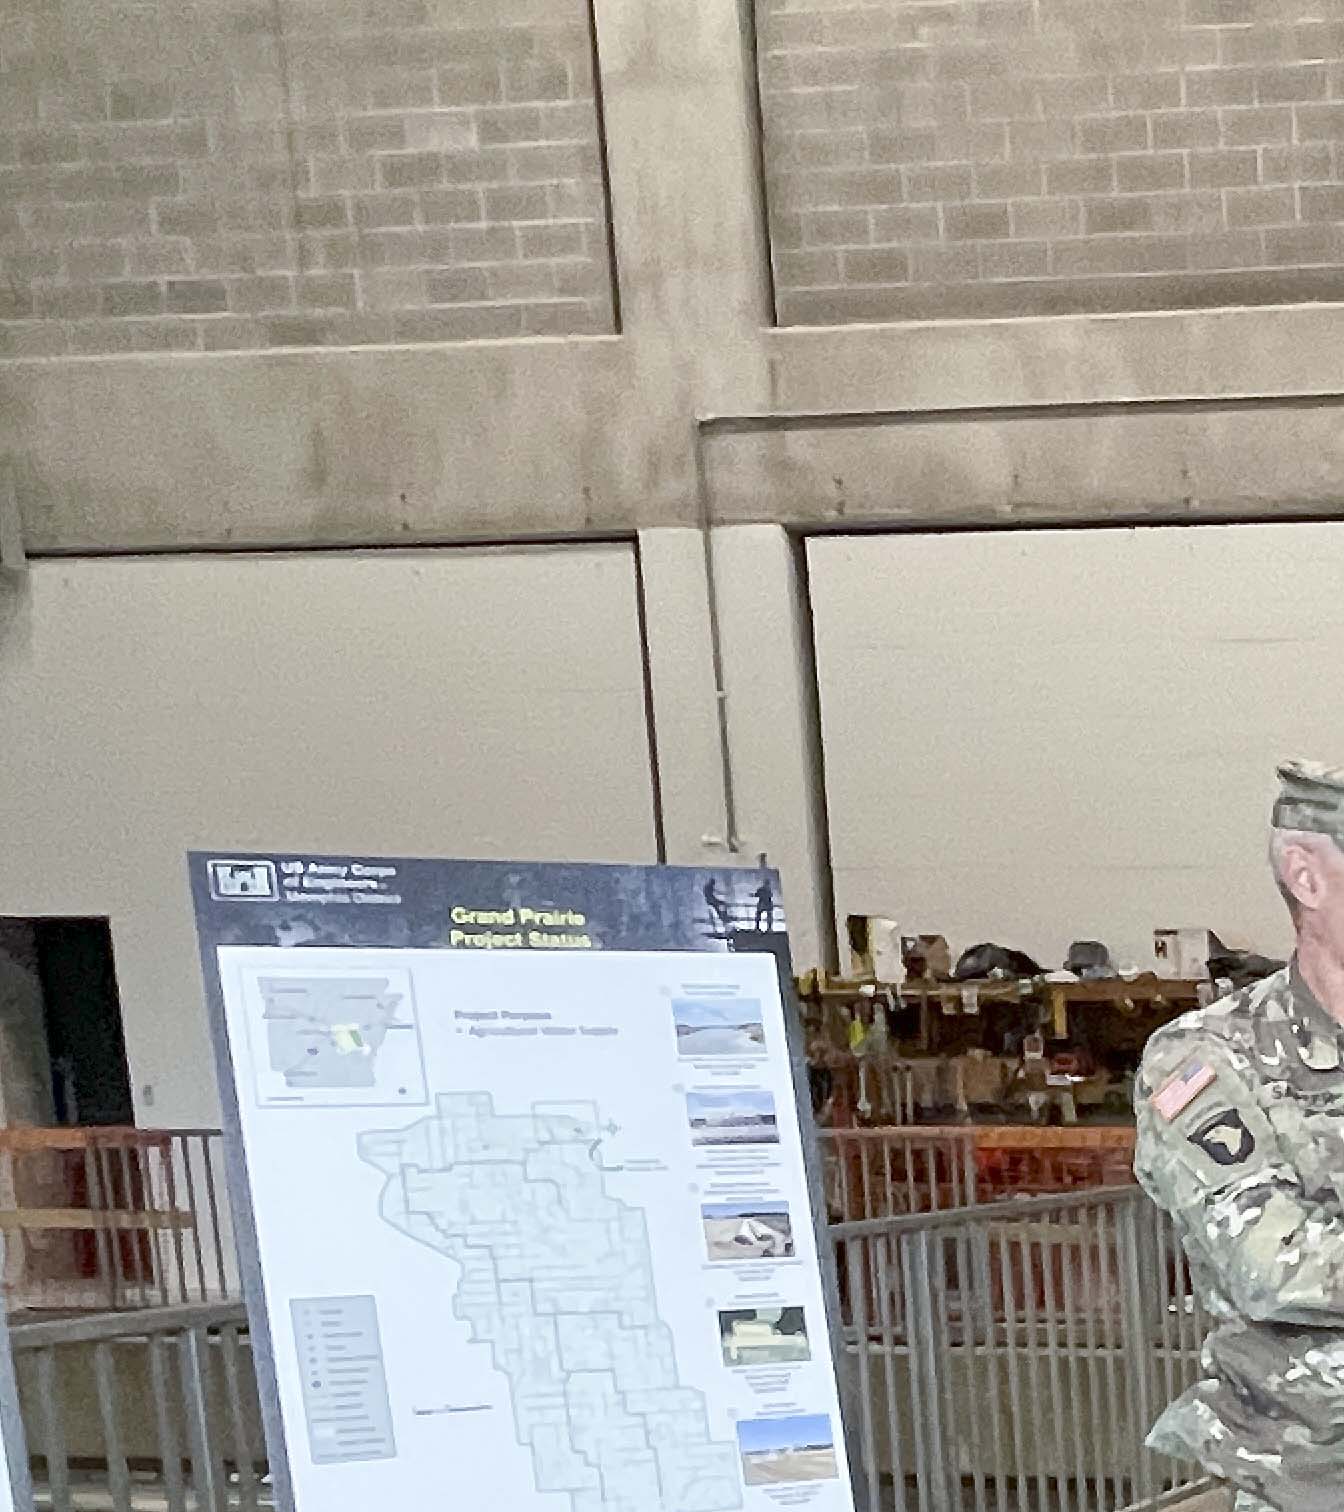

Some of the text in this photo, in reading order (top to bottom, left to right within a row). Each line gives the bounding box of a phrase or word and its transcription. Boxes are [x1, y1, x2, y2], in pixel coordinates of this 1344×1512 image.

[451, 906, 586, 926] Grand Prairie
[450, 930, 592, 950] Project Status
